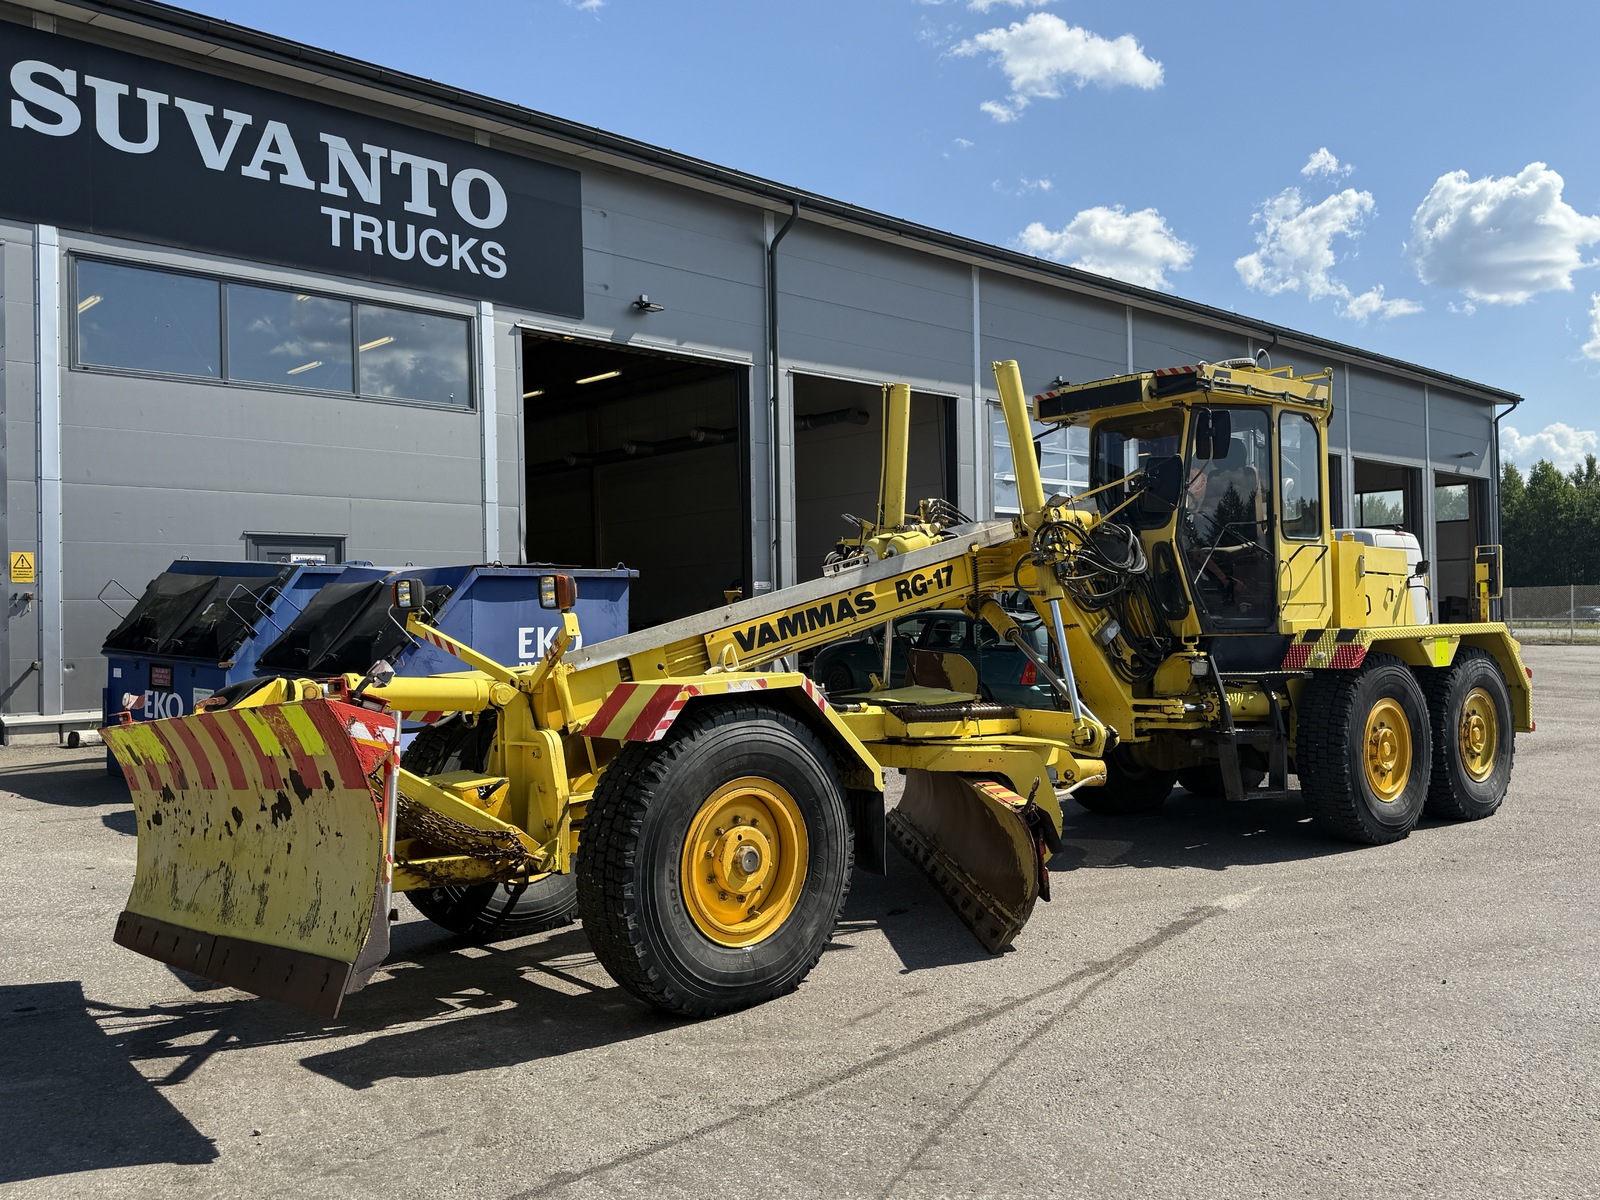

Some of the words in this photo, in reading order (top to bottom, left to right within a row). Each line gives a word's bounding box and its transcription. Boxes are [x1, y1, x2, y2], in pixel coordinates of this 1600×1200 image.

[9, 59, 508, 230] SUVANTO
[320, 206, 508, 279] TRUCKS
[732, 591, 877, 653] VAMMAS
[895, 565, 954, 602] RG-17
[144, 689, 184, 718] EKO
